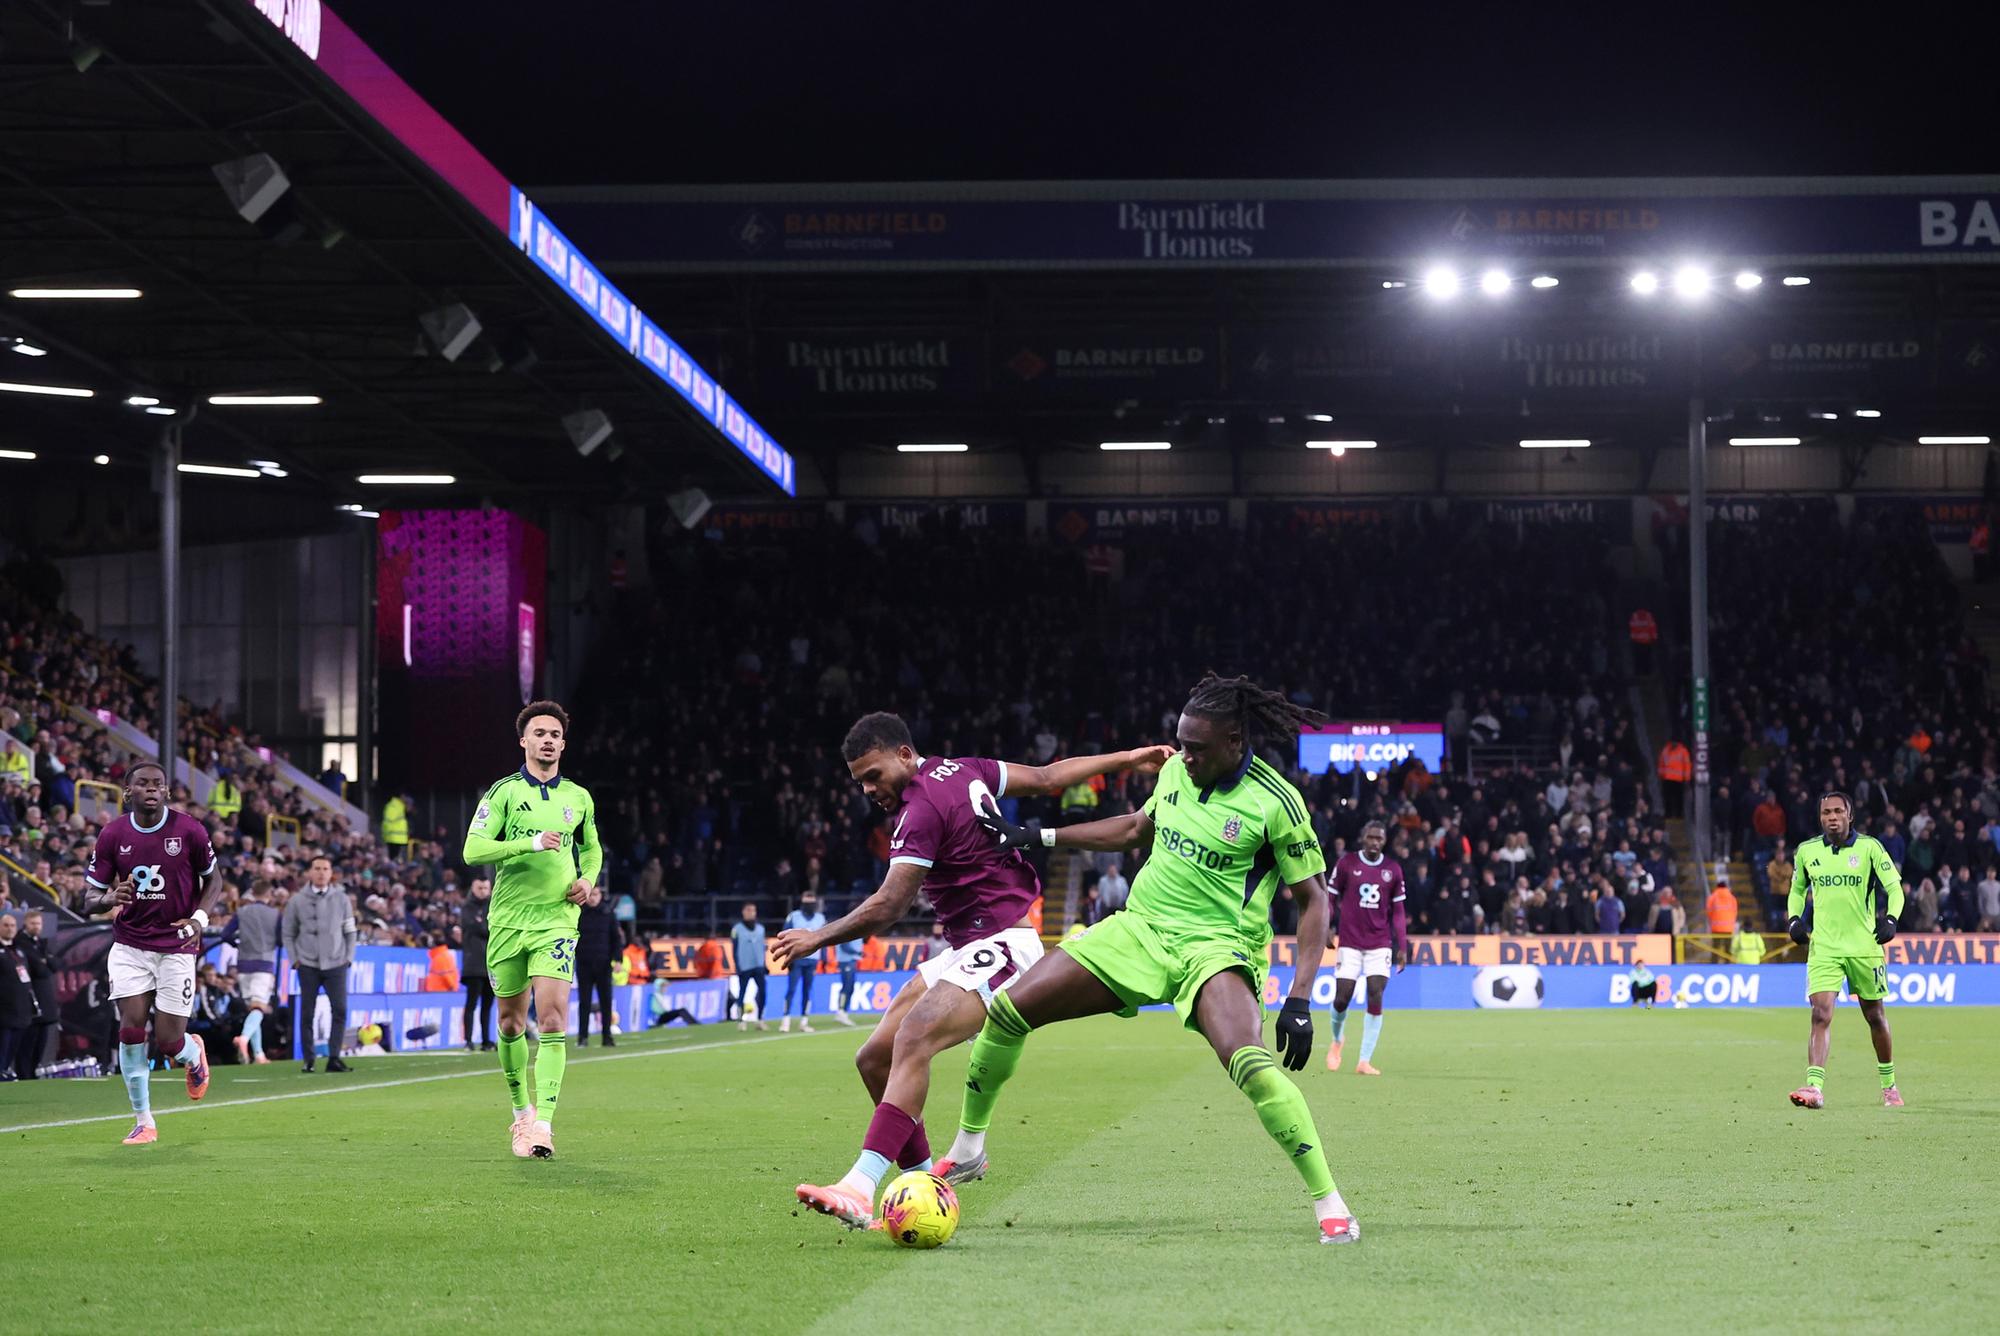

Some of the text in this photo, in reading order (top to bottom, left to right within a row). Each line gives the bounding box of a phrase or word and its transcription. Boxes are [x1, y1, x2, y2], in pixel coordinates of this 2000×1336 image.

[784, 212, 945, 234] BARNFIELD
[1119, 202, 1264, 230] Barnfield
[1920, 200, 2000, 246] BA
[1144, 230, 1254, 258] Homes
[1055, 347, 1204, 366] BARNFIELD
[1769, 341, 1920, 360] BARNFIELD
[1161, 827, 1233, 871] SBOTOP
[132, 864, 165, 892] 96
[1819, 875, 1862, 887] SBOTOP
[136, 892, 166, 900] 96.com
[1889, 940, 2000, 964] EWALT
[1609, 973, 1760, 1004] B8.COM
